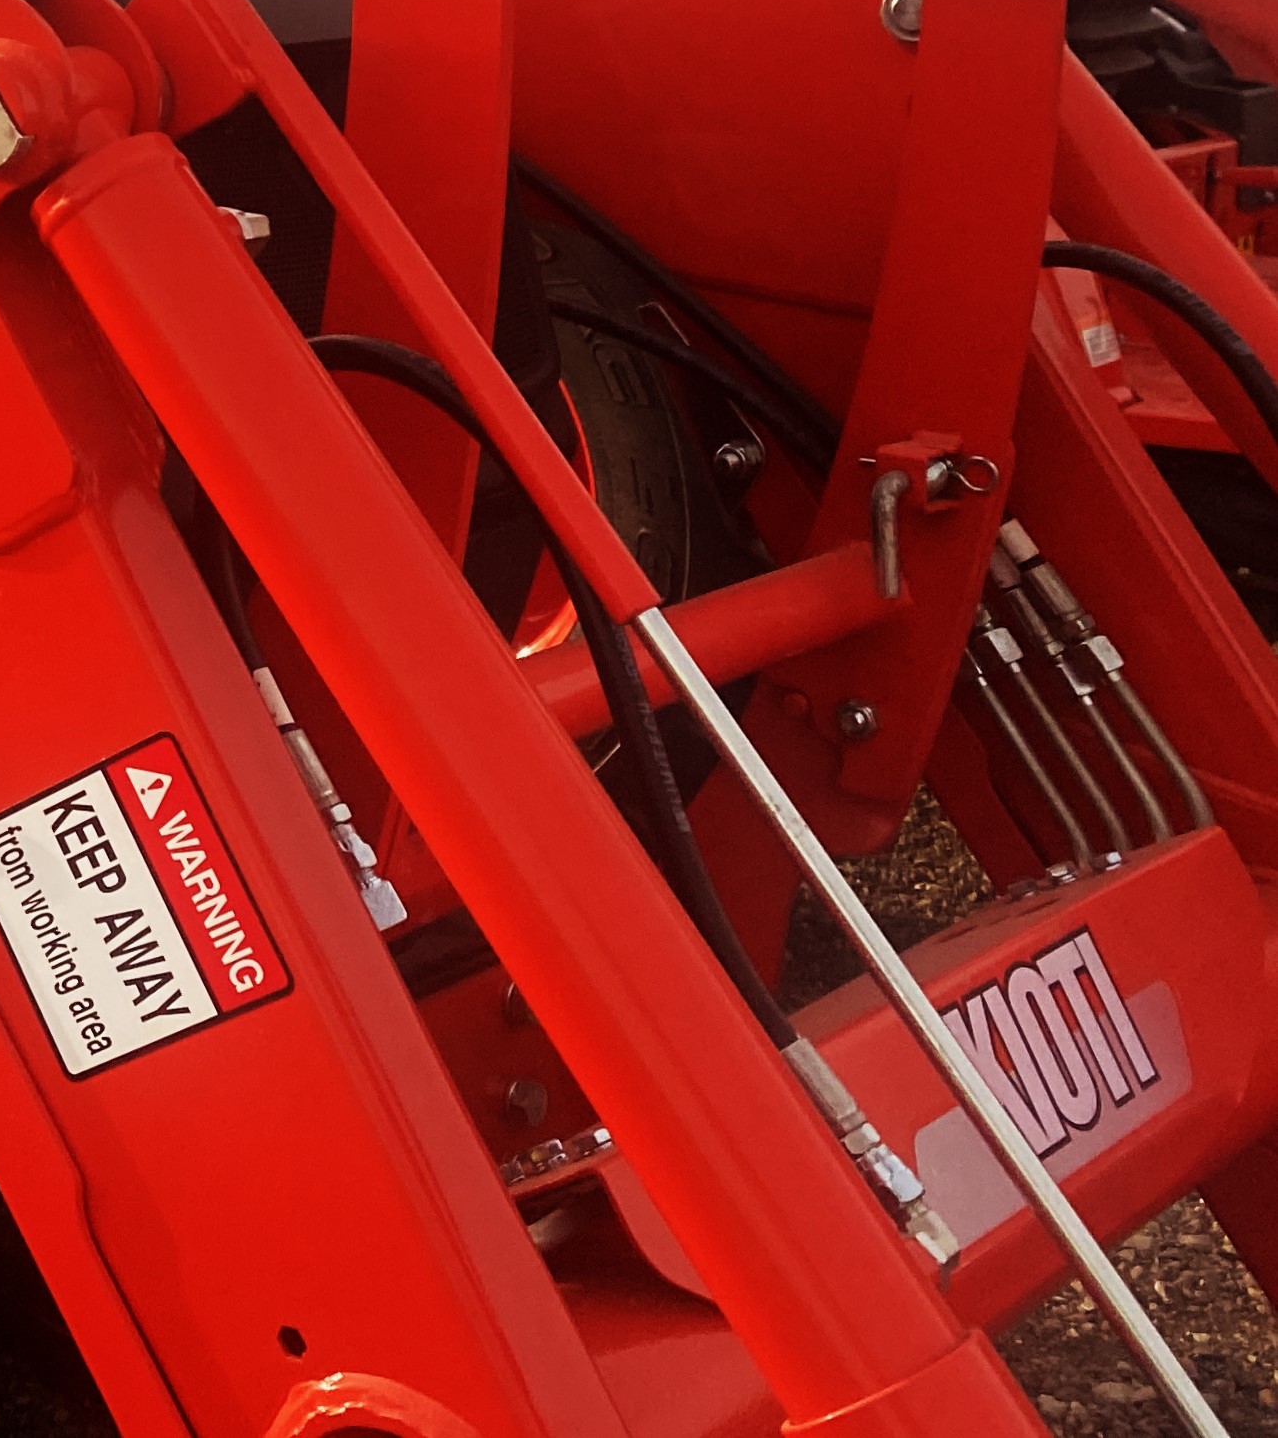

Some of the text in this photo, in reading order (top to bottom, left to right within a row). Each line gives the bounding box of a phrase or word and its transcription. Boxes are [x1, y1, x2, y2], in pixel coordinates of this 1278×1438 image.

[21, 889, 85, 995] working
[69, 997, 112, 1055] area
[44, 790, 191, 1023] KEEP AWAY
[159, 810, 264, 993] WARNING
[941, 924, 1162, 1162] KIOTI
